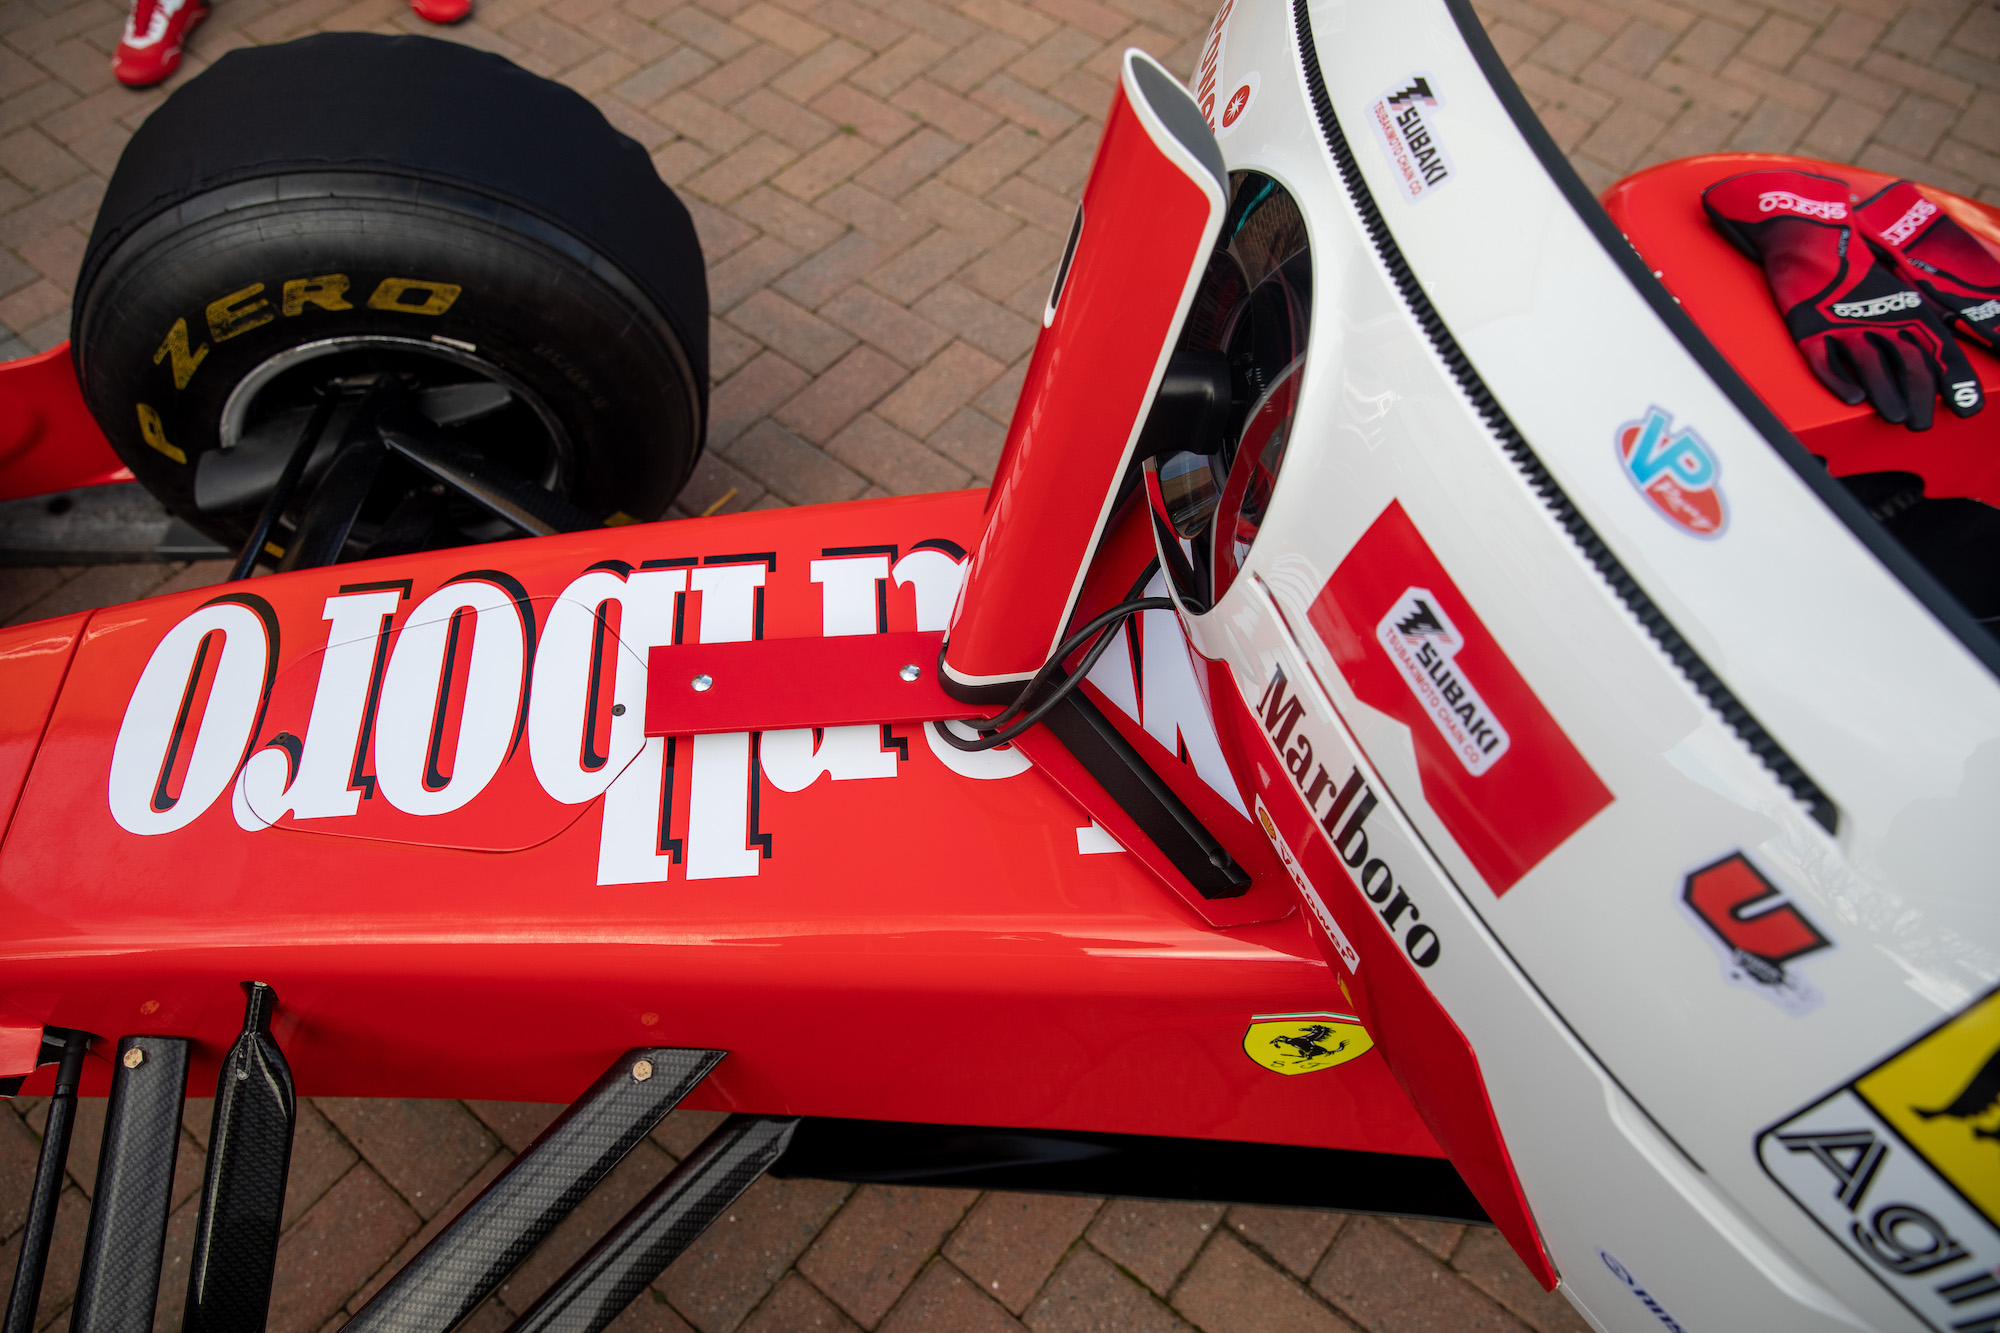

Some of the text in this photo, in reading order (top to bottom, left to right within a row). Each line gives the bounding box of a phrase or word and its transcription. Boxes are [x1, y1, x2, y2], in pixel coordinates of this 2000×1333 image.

[1397, 154, 1416, 182] CHAIN
[1758, 190, 1848, 220] sparco
[153, 273, 463, 390] ZERO
[1832, 291, 1922, 318] sparco
[136, 402, 188, 465] P
[1629, 410, 1716, 487] VP
[1386, 627, 1441, 709] TSUBAKIMOTO
[1438, 707, 1467, 745] CHAIN
[1395, 600, 1500, 754] TSUBAKI
[1256, 662, 1441, 968] Marlboro
